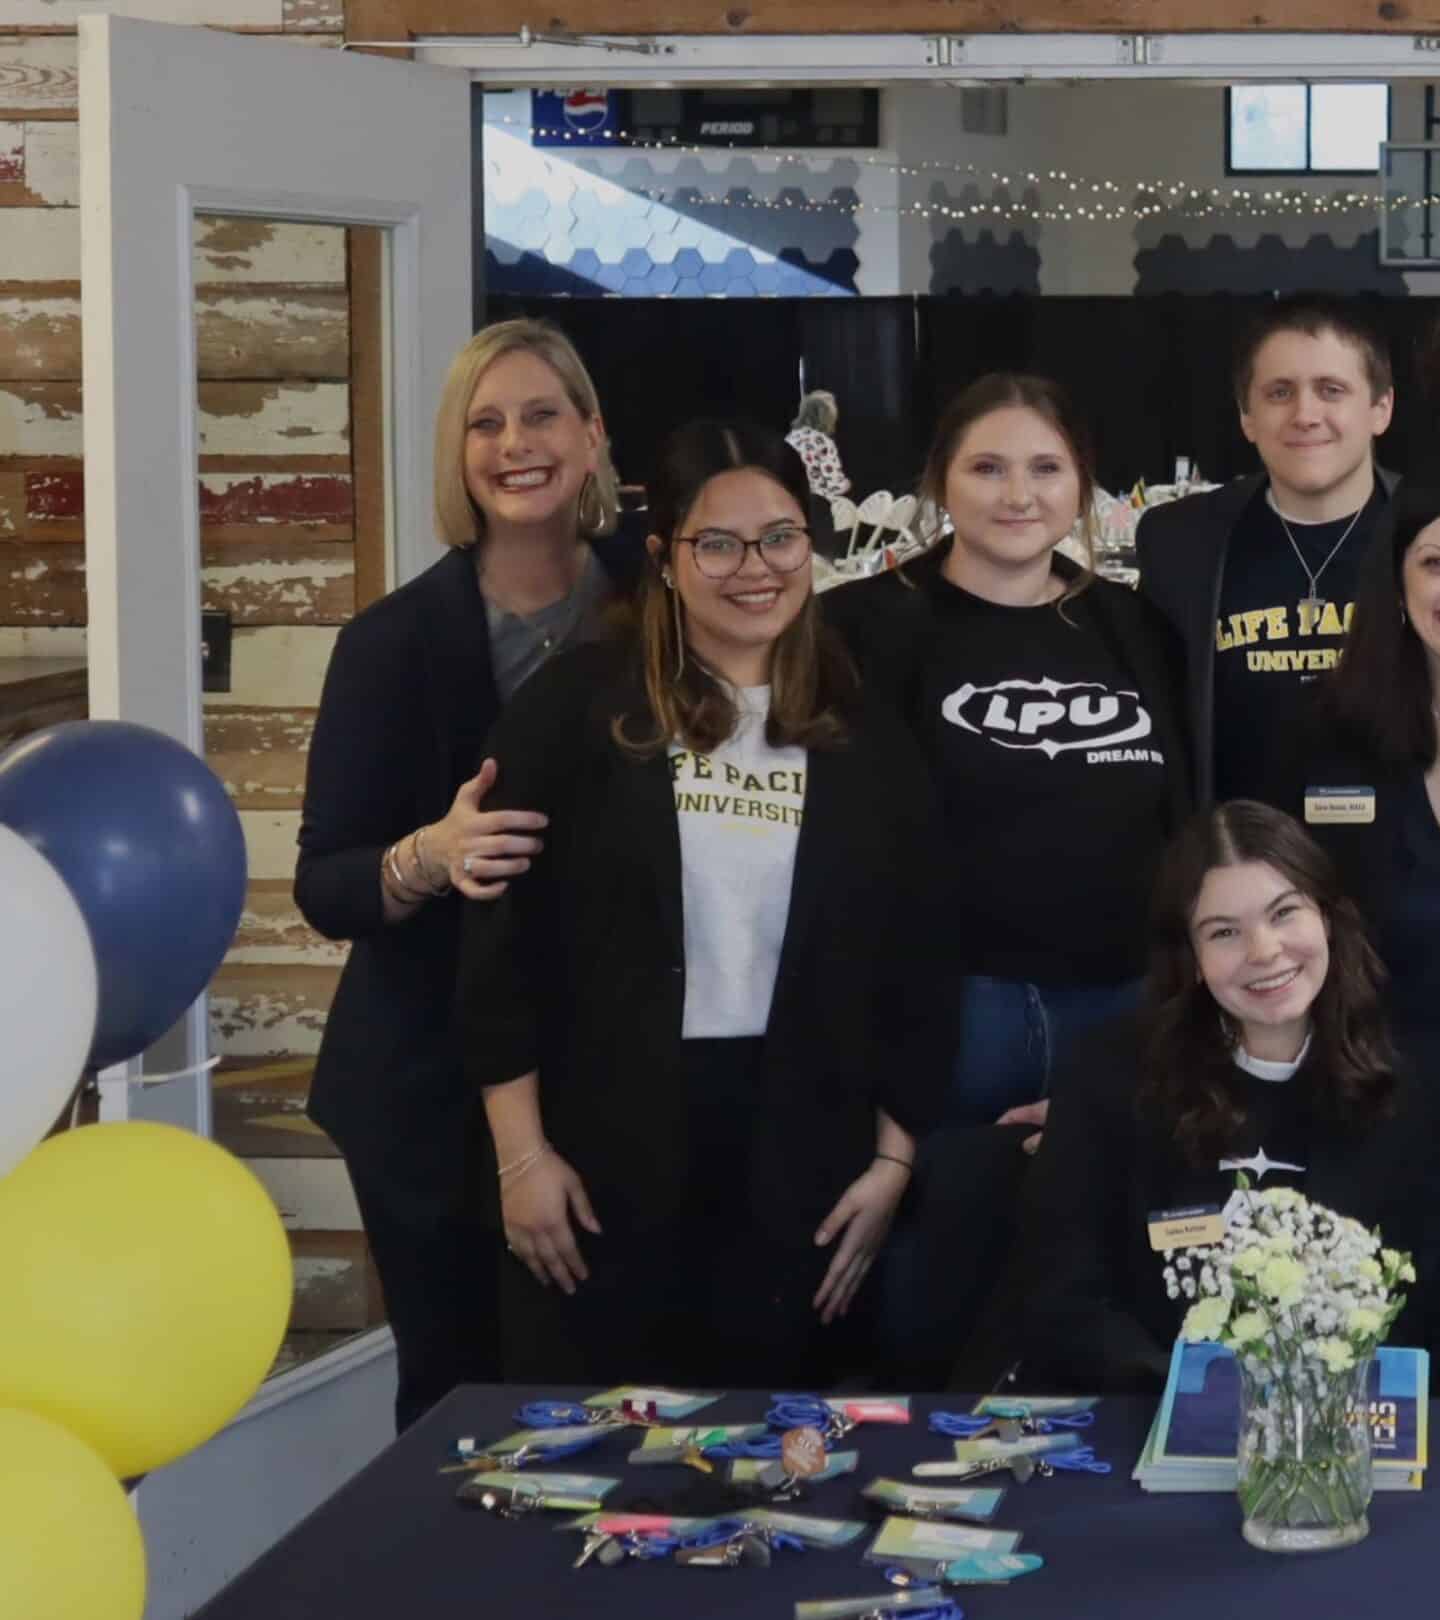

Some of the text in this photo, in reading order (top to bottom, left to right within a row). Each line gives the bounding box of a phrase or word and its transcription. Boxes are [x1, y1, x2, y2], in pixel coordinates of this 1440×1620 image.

[700, 121, 754, 136] PERIOD
[1216, 606, 1288, 652] LIFE
[1247, 648, 1344, 672] UNIVER
[982, 694, 1119, 735] LPU
[1087, 750, 1149, 764] DREAM
